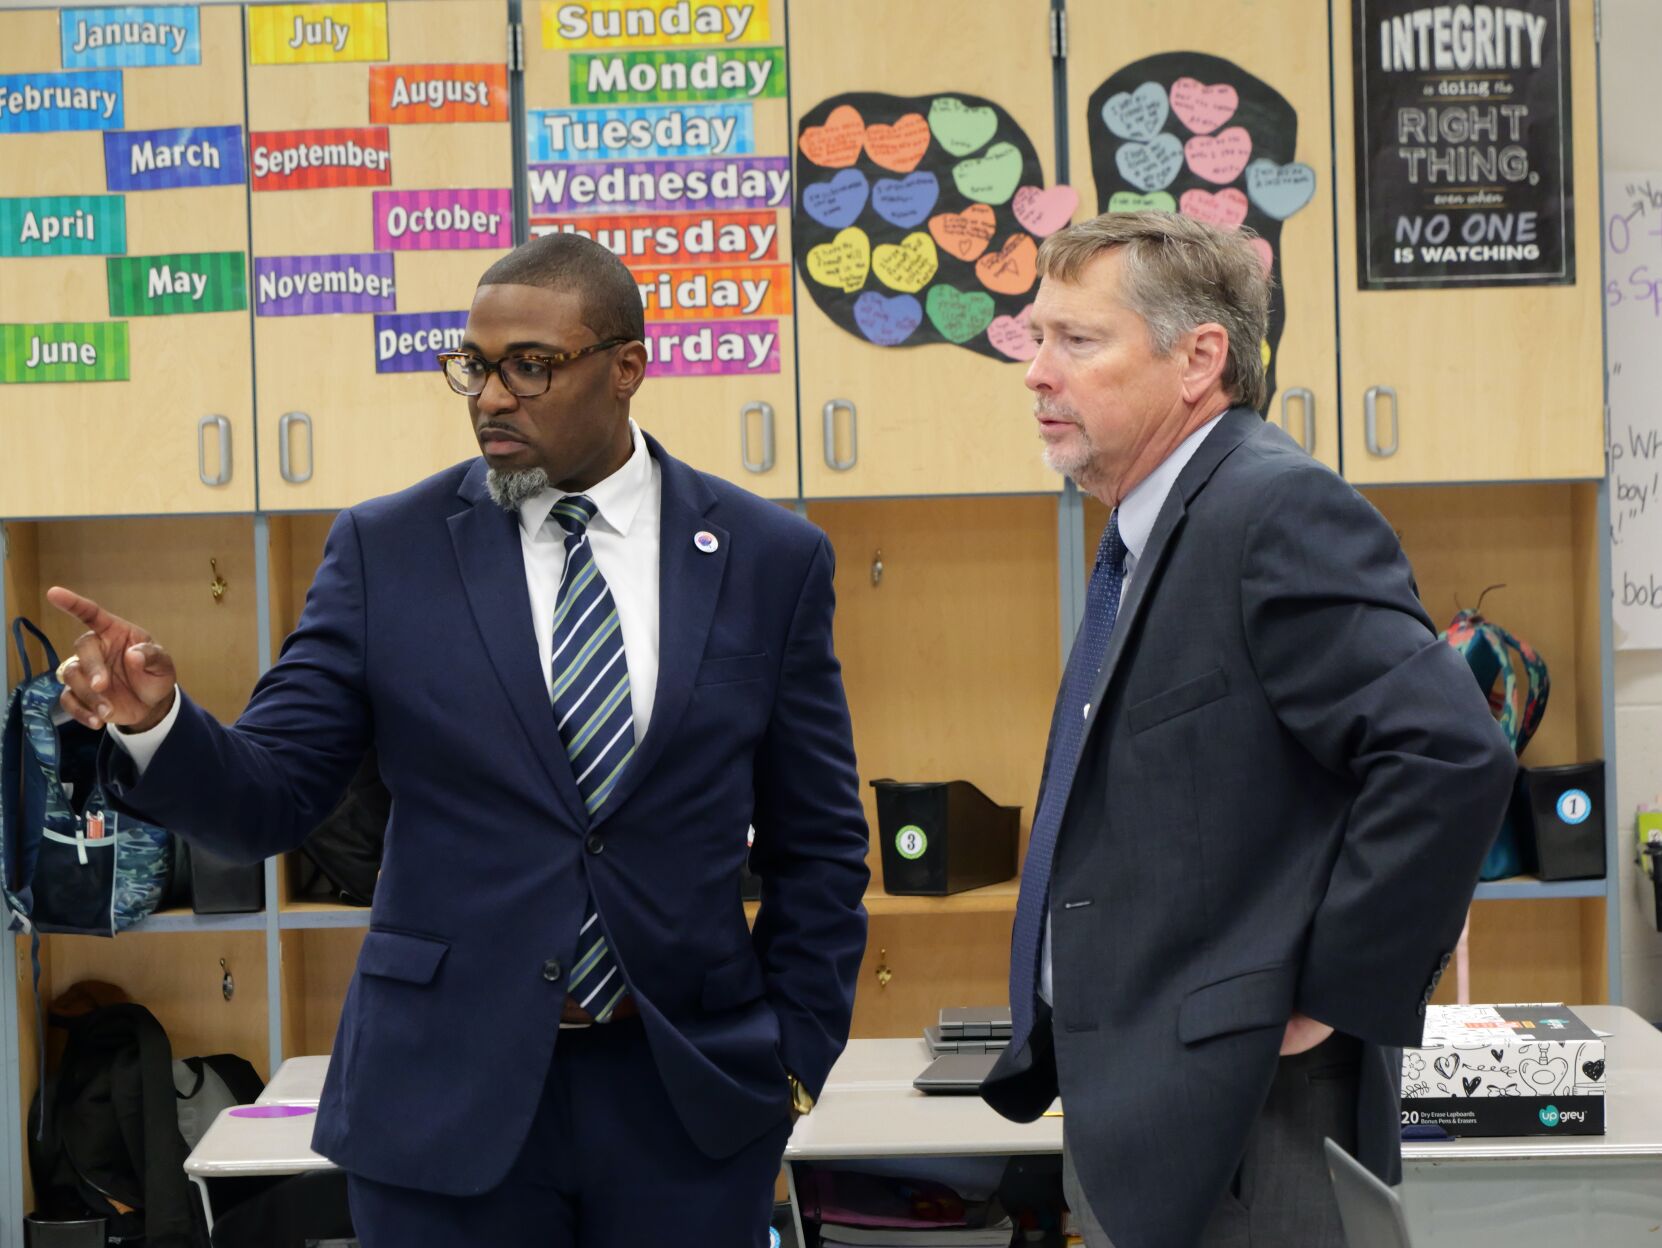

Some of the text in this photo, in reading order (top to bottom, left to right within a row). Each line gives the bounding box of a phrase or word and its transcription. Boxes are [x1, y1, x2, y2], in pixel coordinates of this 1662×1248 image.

[73, 20, 187, 54] January
[289, 17, 350, 51] July
[557, 1, 754, 41] Sunday
[1380, 4, 1547, 72] INTEGRITY
[390, 77, 489, 109] August
[587, 55, 773, 96] Monday
[1438, 79, 1490, 97] doing
[543, 112, 736, 154] Tuesday
[1397, 104, 1529, 143] RIGHT
[130, 140, 220, 175] March
[253, 142, 390, 178] September
[1398, 145, 1541, 186] THING.
[528, 164, 791, 206] Wednesday
[1466, 188, 1504, 204] when
[20, 210, 95, 244] April
[386, 205, 500, 237] October
[1395, 211, 1538, 246] NO ONE
[530, 219, 777, 260] ursday
[1394, 244, 1541, 264] IS WATCHING
[147, 265, 208, 300] May
[258, 267, 393, 303] November
[637, 273, 770, 315] riday
[26, 335, 97, 369] June
[379, 328, 467, 361] Decem
[1569, 797, 1577, 815] 1
[907, 833, 915, 849] 3
[1400, 1110, 1419, 1125] 20
